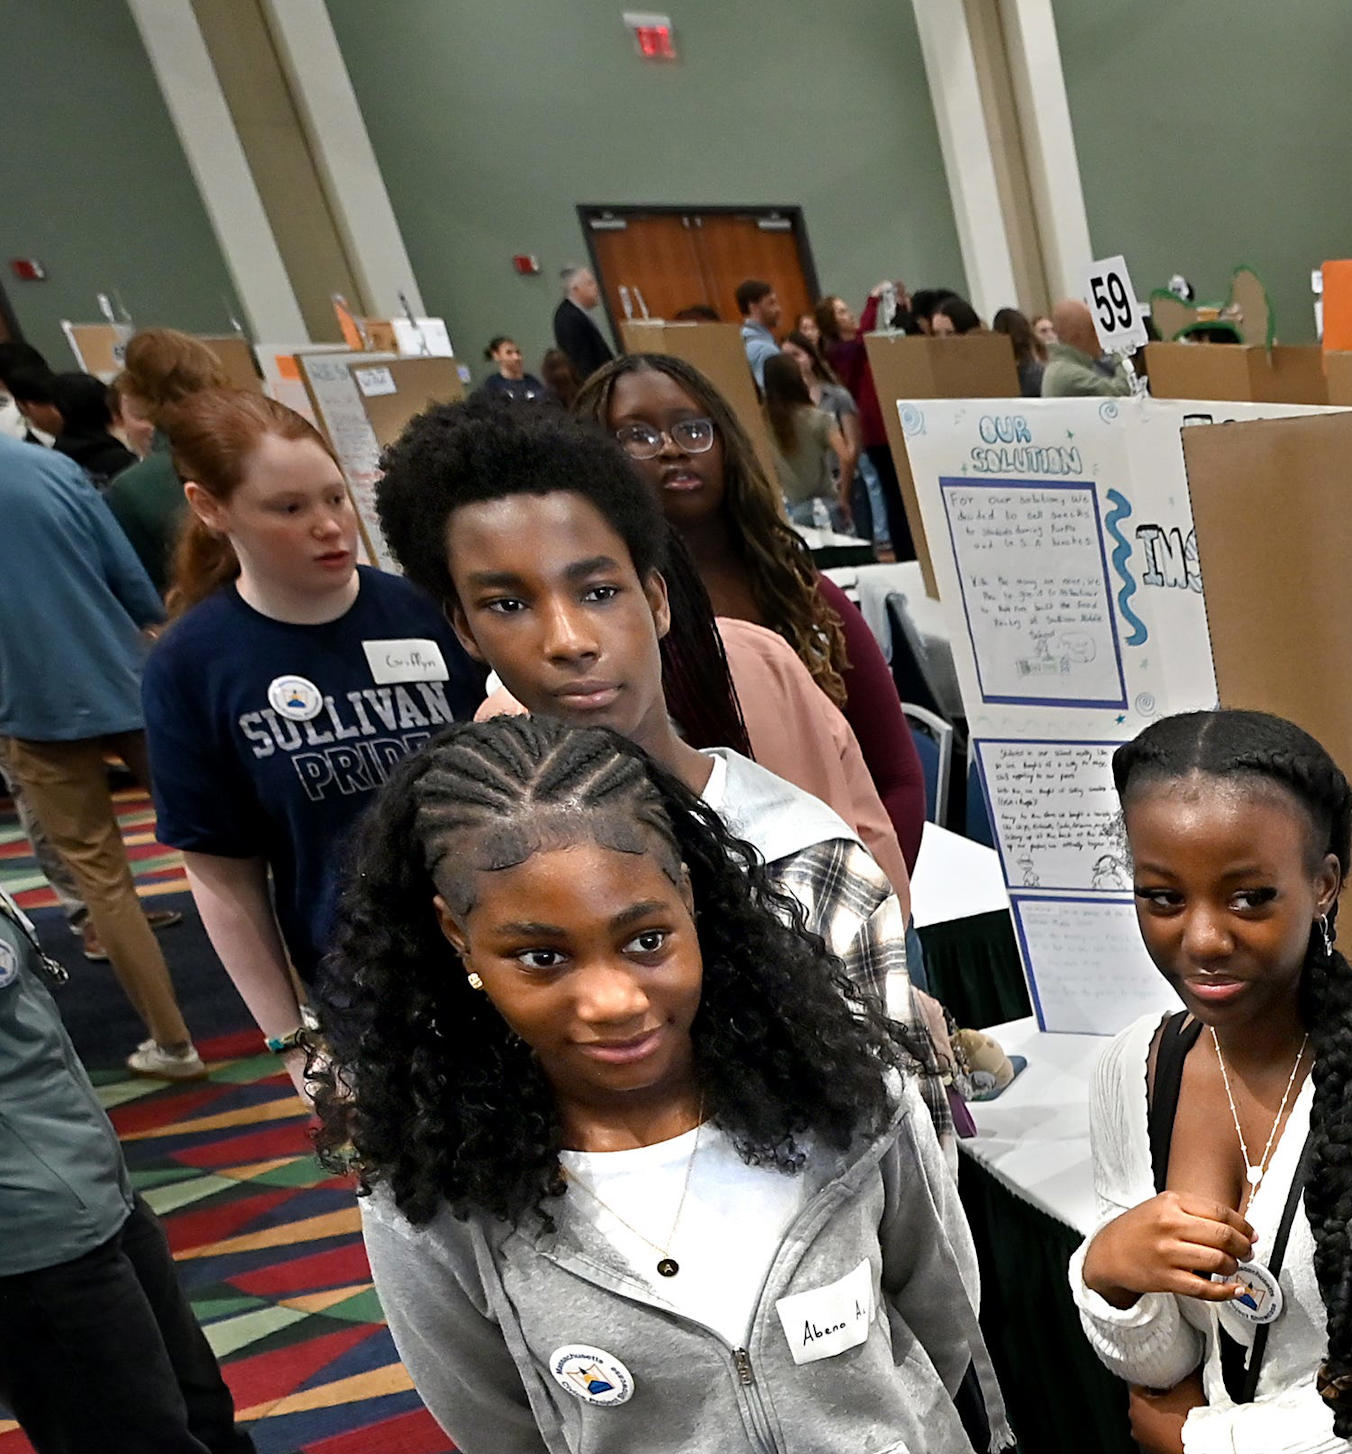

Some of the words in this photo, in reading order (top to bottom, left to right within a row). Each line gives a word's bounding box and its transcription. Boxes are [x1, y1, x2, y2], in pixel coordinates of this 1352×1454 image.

[1090, 272, 1132, 332] 59
[979, 415, 1032, 444] OUR
[971, 446, 1083, 476] SOLUTION
[950, 492, 974, 507] For
